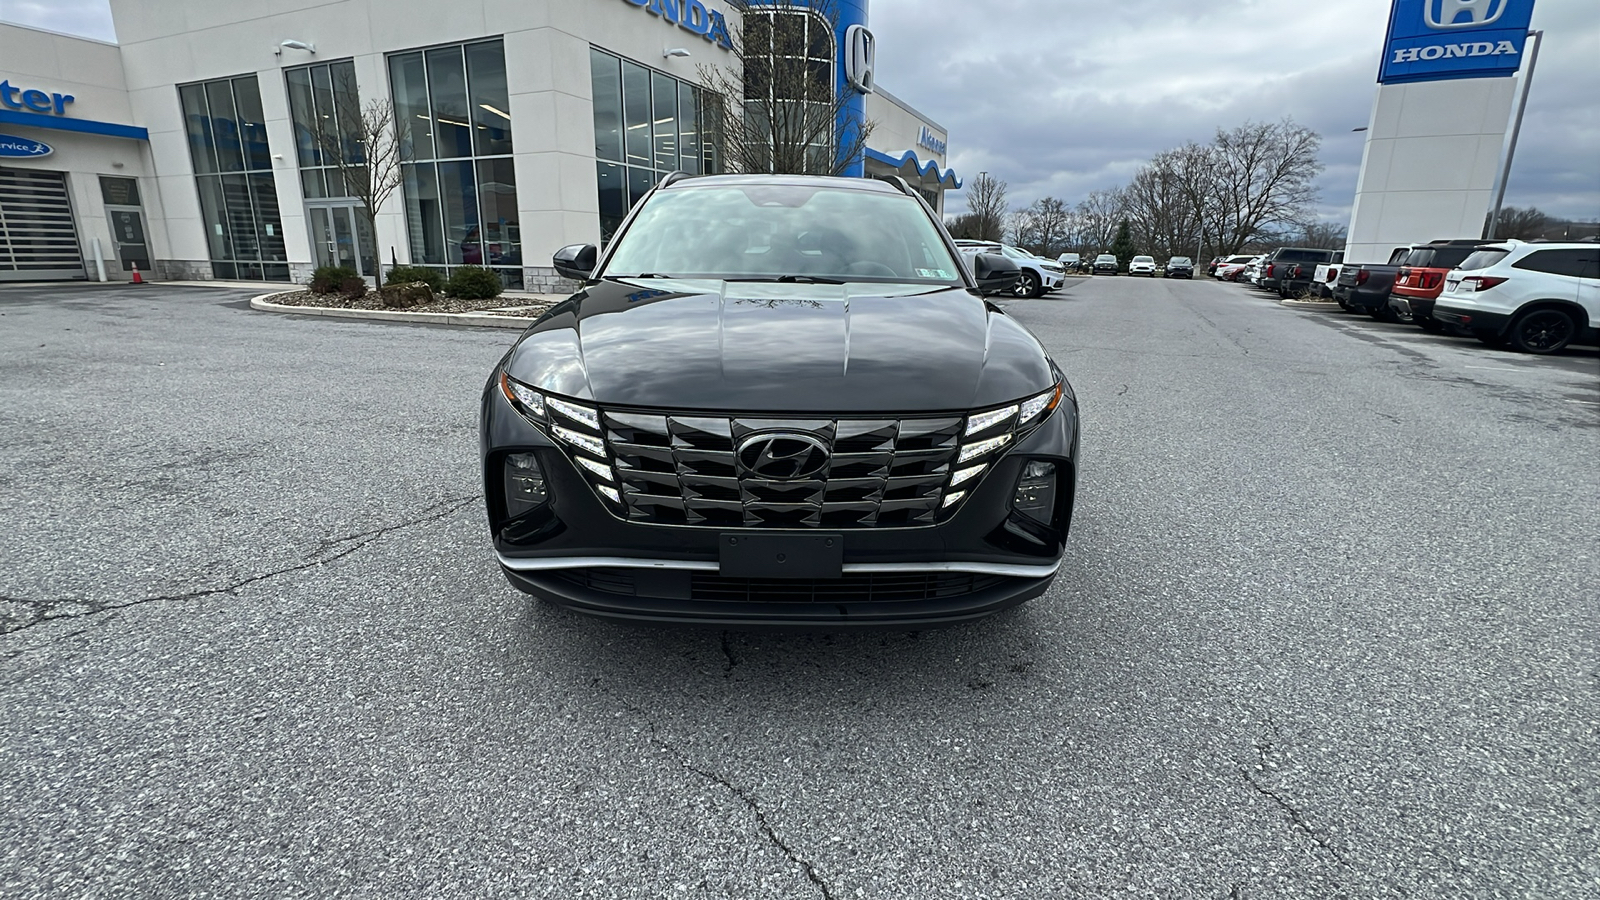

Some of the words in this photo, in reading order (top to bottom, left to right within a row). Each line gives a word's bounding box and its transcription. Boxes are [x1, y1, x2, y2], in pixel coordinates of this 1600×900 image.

[622, 0, 734, 51] NDA
[1392, 40, 1518, 63] HONDA
[0, 79, 75, 114] ter
[0, 142, 29, 151] rvice
